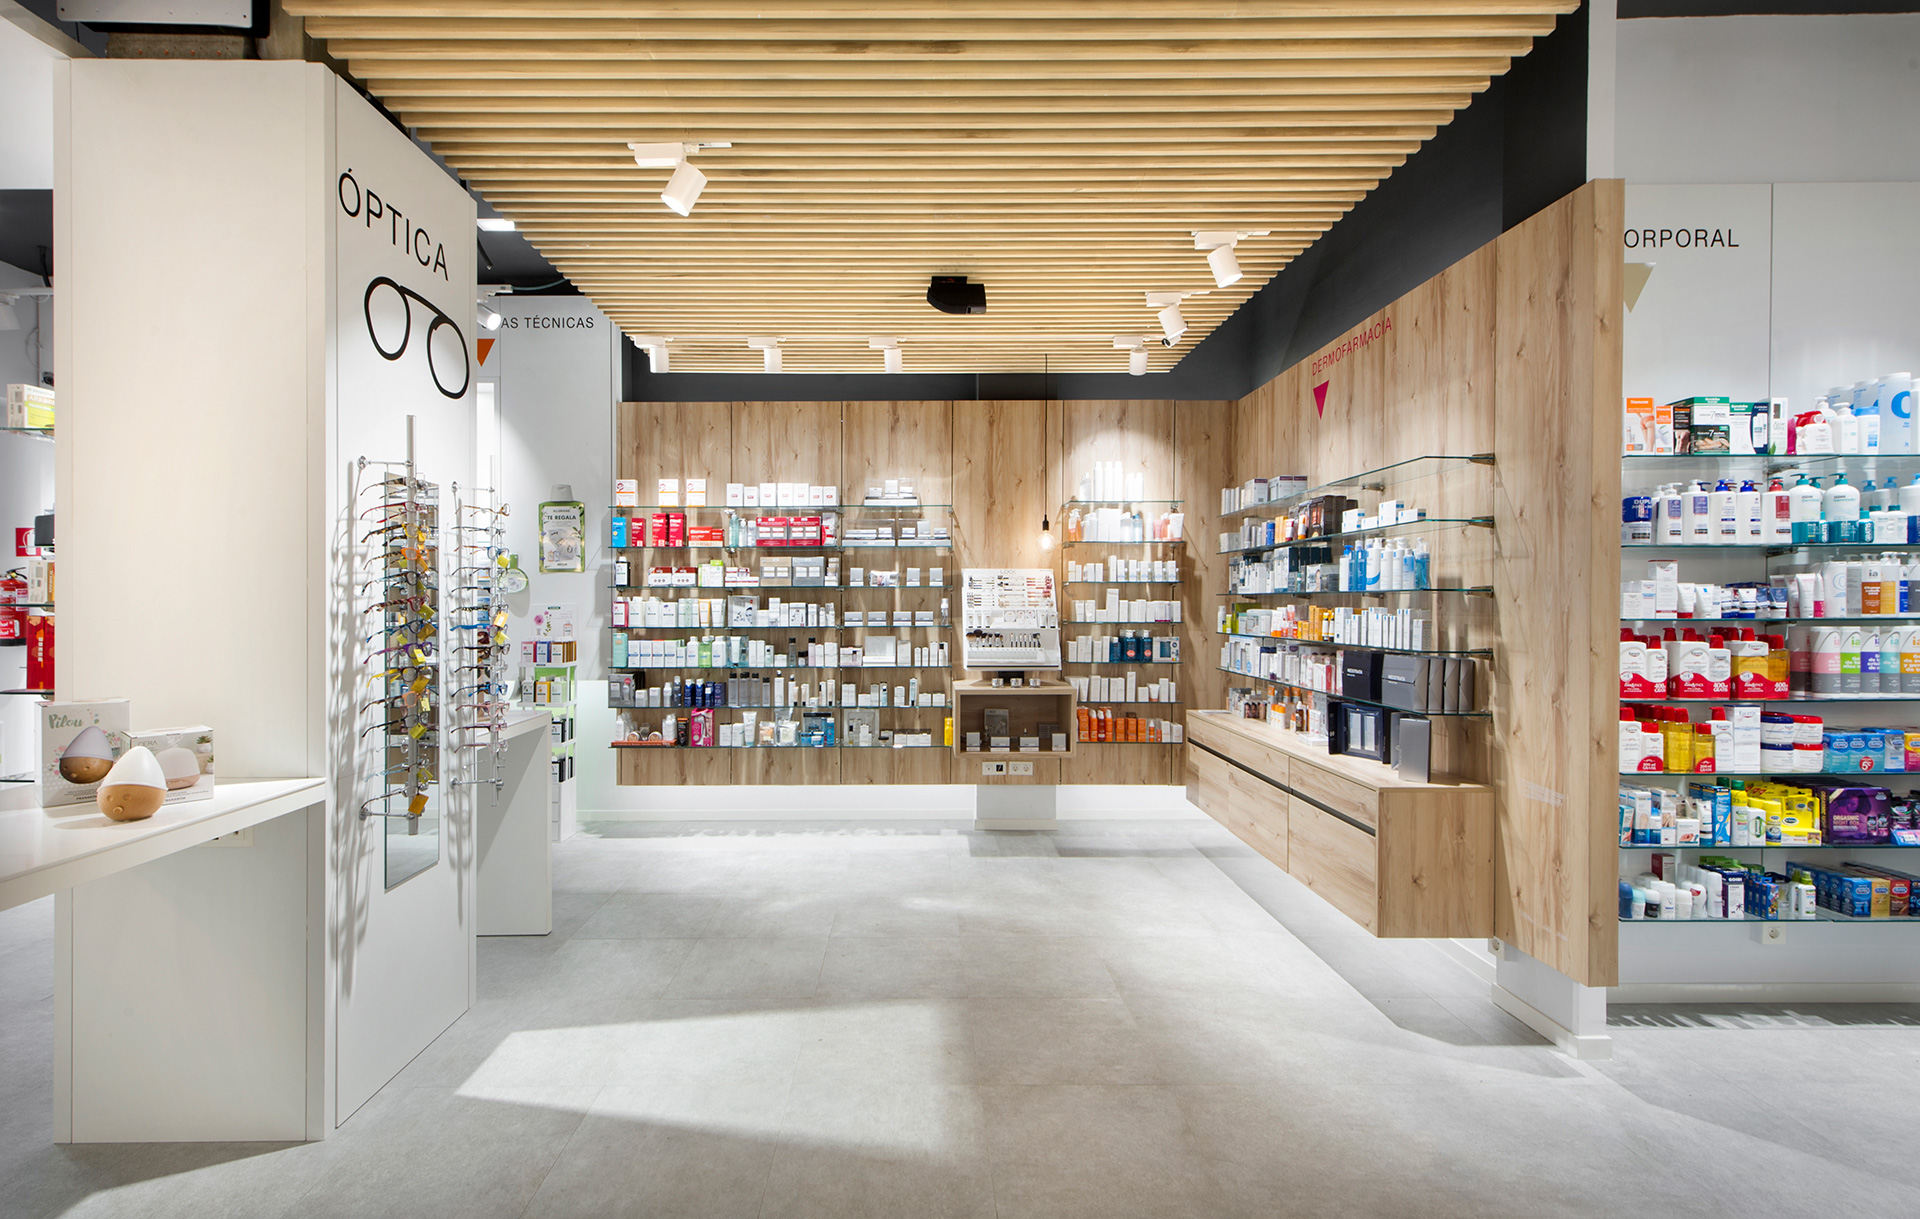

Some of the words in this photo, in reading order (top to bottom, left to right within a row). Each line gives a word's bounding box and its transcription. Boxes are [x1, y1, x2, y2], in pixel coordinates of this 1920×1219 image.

[338, 167, 449, 281] ÓPTICA
[1623, 228, 1740, 248] ORPORAL
[524, 314, 595, 329] TÉCNICAS
[1311, 316, 1393, 377] DERMOFARMACIA
[48, 714, 83, 729] Pilou
